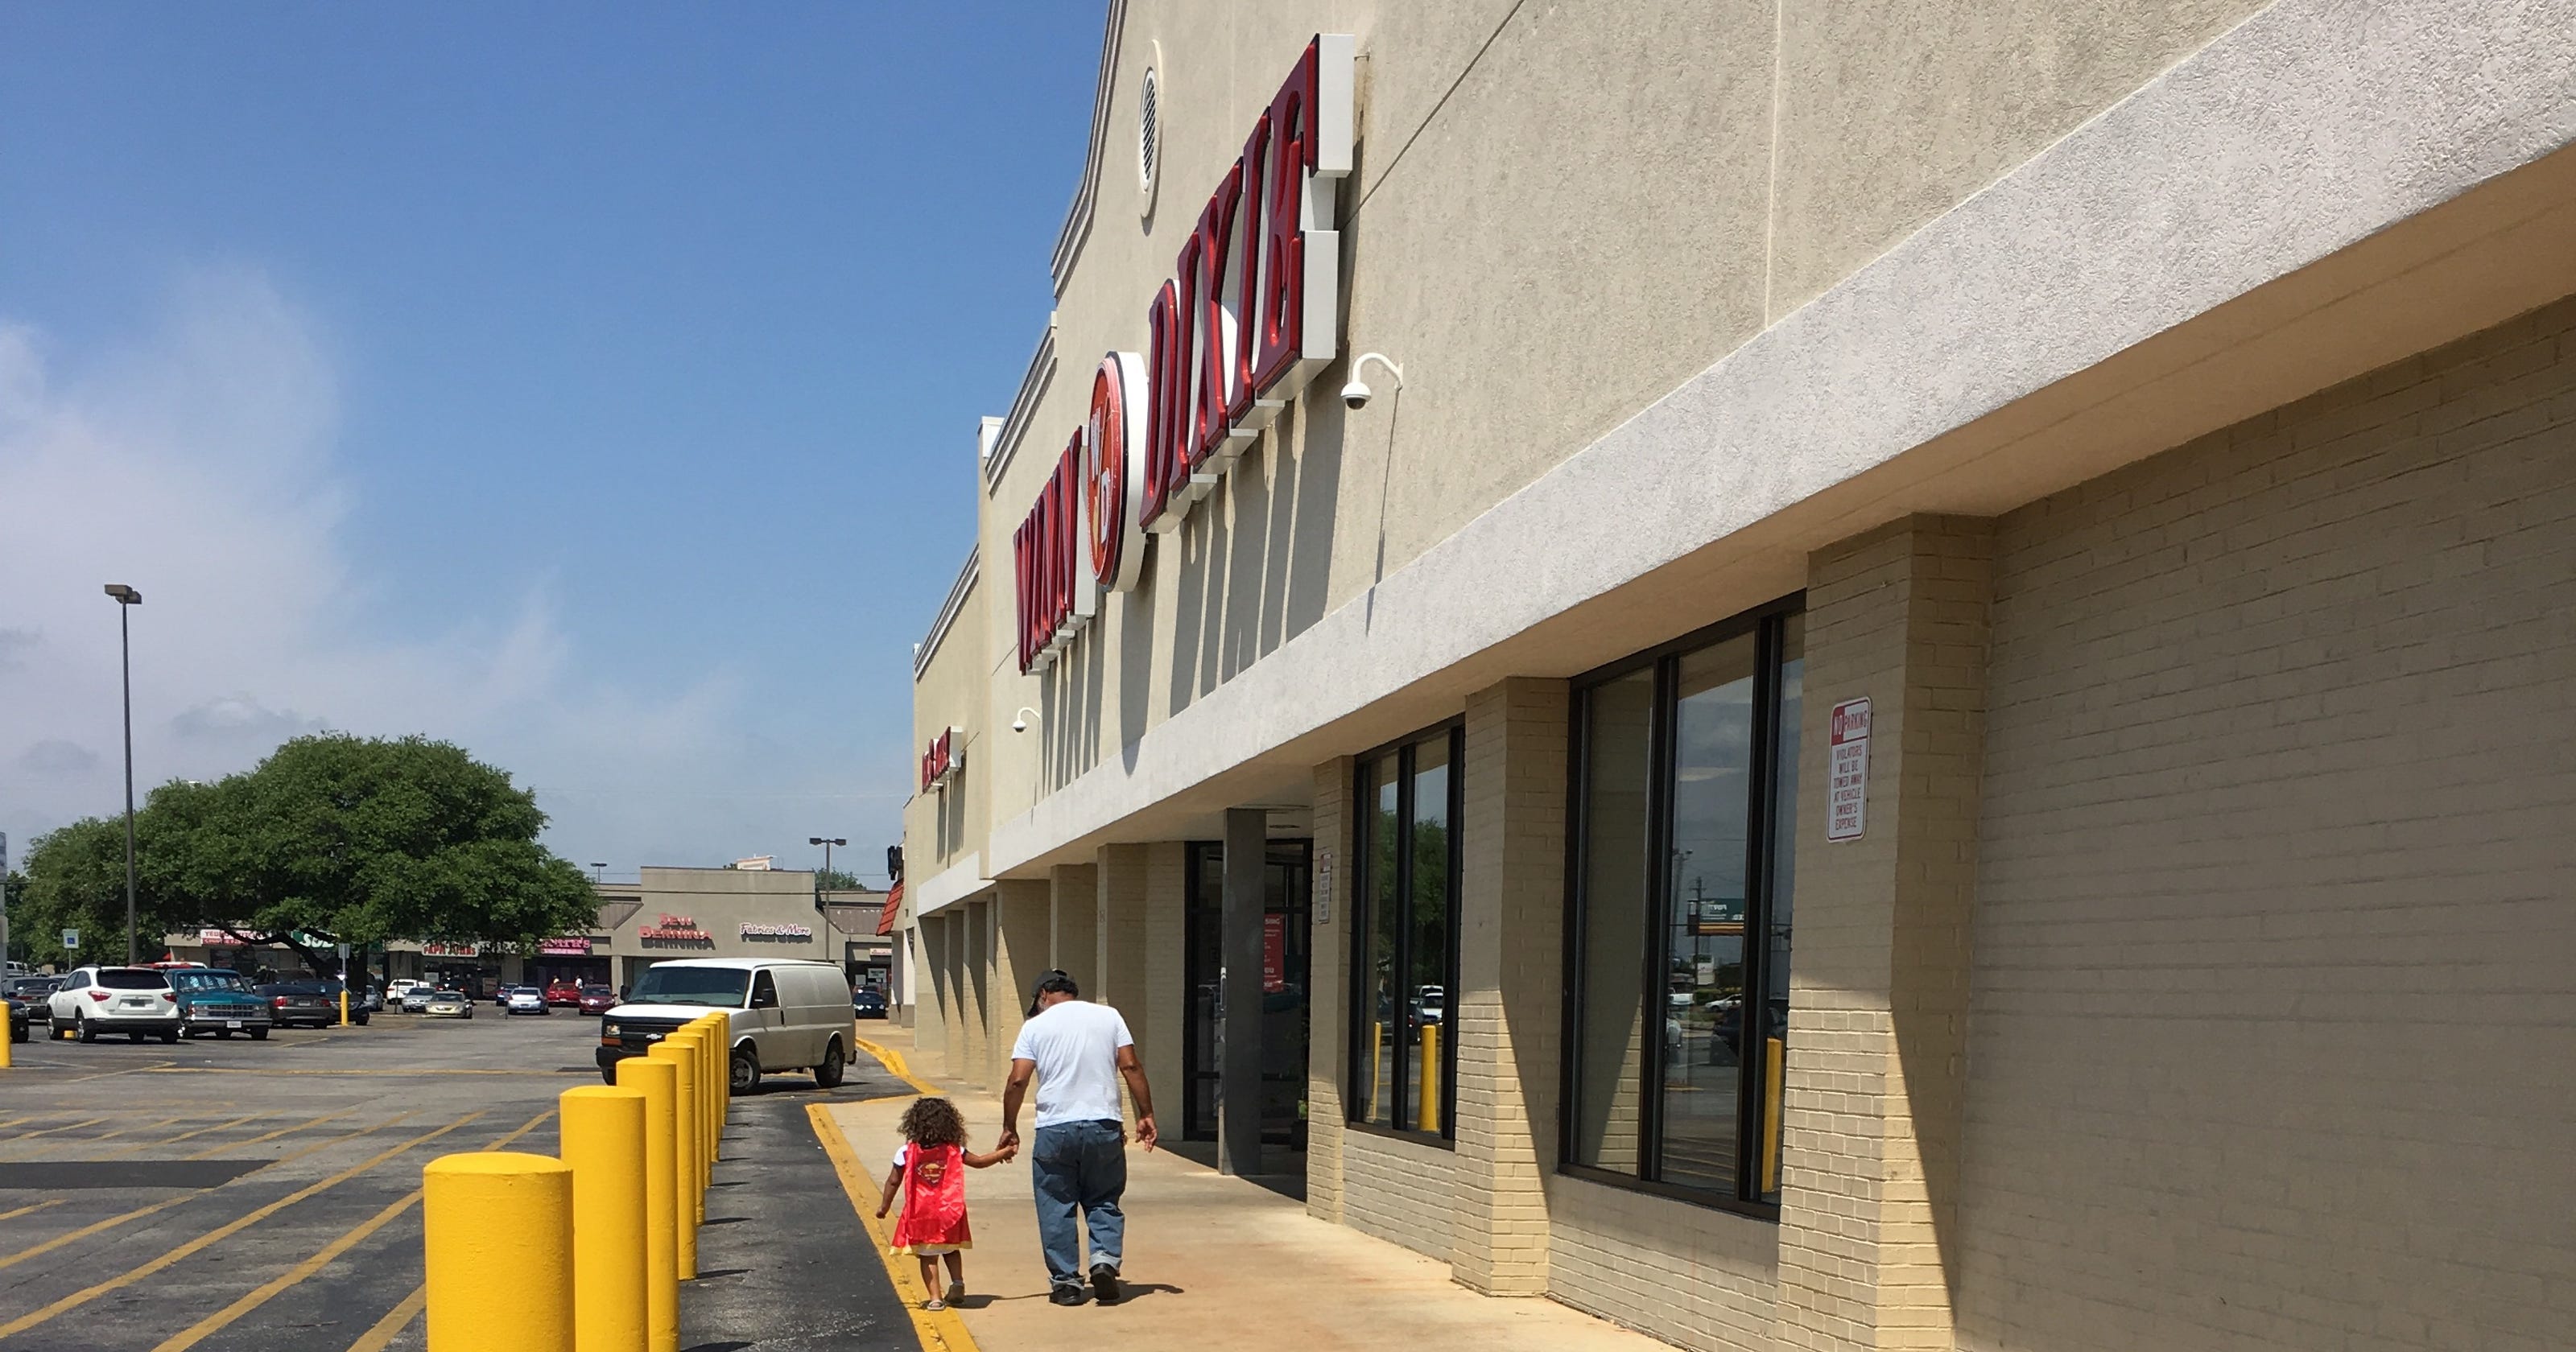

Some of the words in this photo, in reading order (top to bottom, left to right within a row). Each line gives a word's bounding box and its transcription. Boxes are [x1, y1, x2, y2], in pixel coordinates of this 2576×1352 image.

[1139, 33, 1321, 534] DIXIE
[1834, 715, 1843, 736] NO
[1843, 711, 1868, 732] PARKING
[1836, 744, 1862, 760] VIOLATORS
[1839, 761, 1849, 773] WILL
[1852, 760, 1859, 772] BE
[1834, 776, 1849, 789] TOWED
[1851, 773, 1863, 786] AWAY
[1834, 790, 1840, 802] AT
[1841, 787, 1861, 801] VEHICLE
[1835, 803, 1857, 816] OWNER'S
[1835, 816, 1856, 831] EXPENSE
[638, 925, 713, 939] BERNINA
[740, 921, 774, 935] Fabrics
[775, 925, 784, 935] &
[785, 923, 812, 936] More
